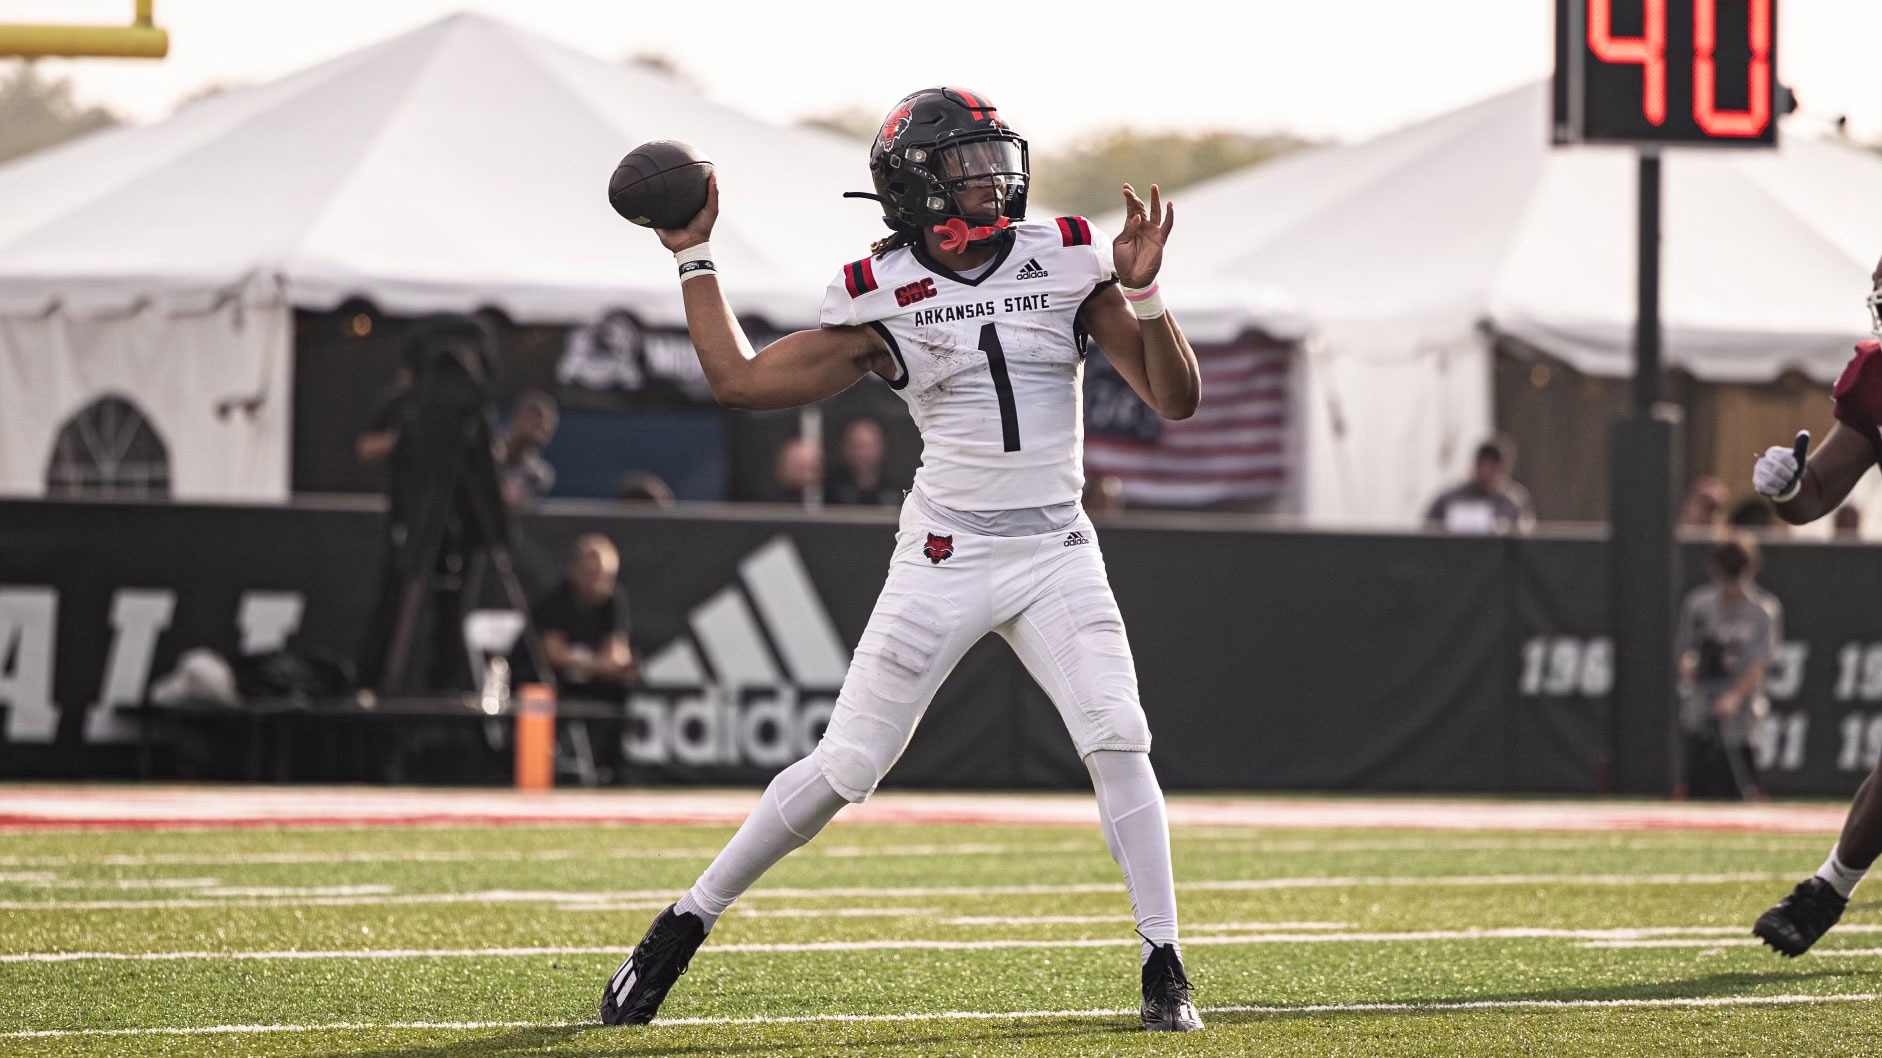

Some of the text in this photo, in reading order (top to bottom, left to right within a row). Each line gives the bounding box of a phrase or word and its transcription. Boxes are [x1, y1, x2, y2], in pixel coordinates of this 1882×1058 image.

[1586, 0, 1771, 137] 40
[1016, 269, 1049, 281] adidas
[914, 293, 1050, 327] ARKANSAS STATE
[977, 322, 1021, 453] 1
[1063, 537, 1089, 547] adidas
[1519, 636, 1614, 697] 196
